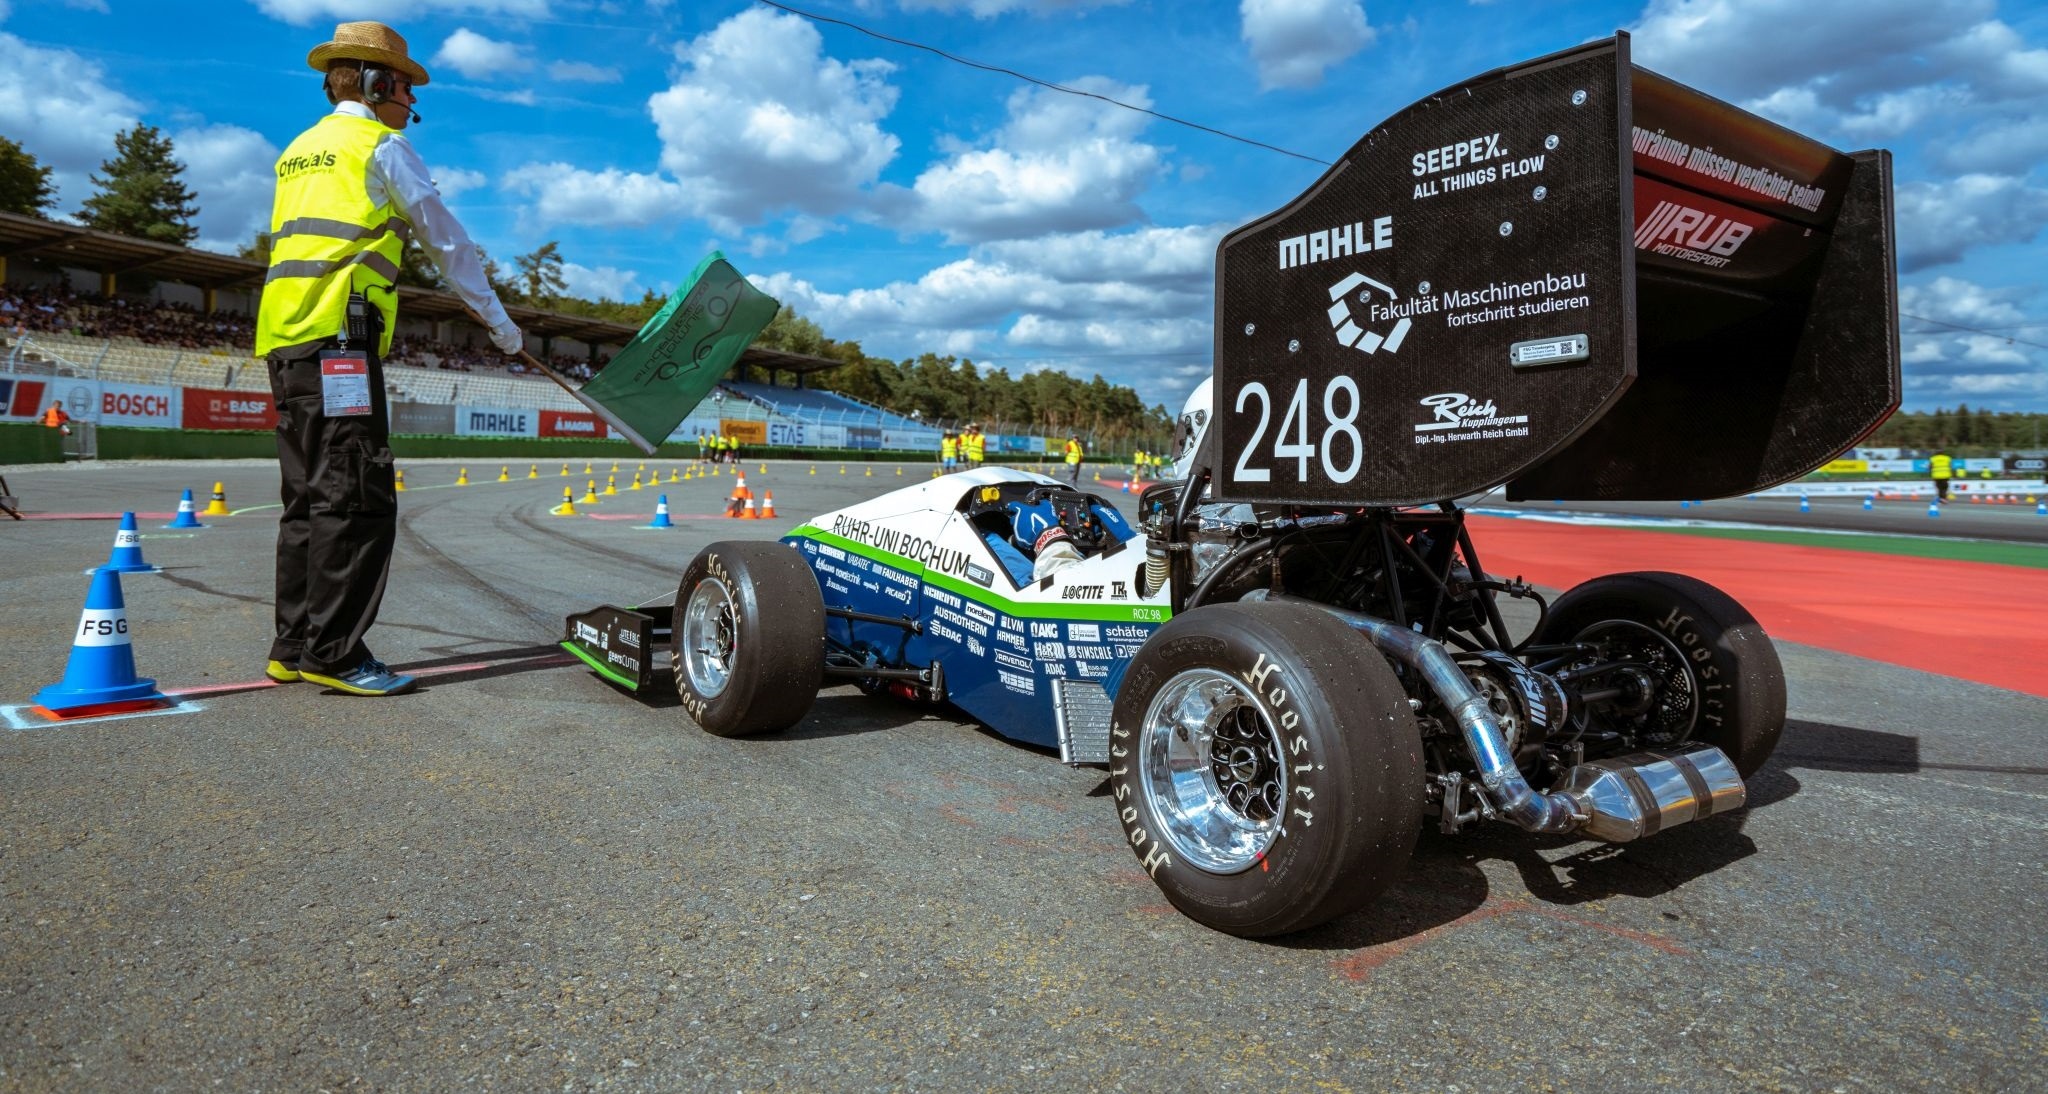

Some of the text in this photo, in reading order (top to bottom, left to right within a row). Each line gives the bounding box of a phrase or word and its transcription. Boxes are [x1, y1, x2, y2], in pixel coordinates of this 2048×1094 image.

[279, 150, 336, 178] Officials
[1412, 133, 1508, 177] SEEPEX.
[1413, 155, 1545, 200] ALL THINGS FLOW
[1685, 146, 1737, 184] müssen
[1734, 160, 1795, 202] verdichtet
[1279, 216, 1393, 270] MAHLE
[1652, 242, 1732, 268] MOTORSPORT
[1371, 273, 1587, 322] Fakultät Maschinenbau
[1447, 295, 1590, 327] fortschritt studieren
[102, 392, 168, 416] BOSCH
[229, 400, 268, 414] BASF
[1420, 393, 1497, 424] Reich
[470, 412, 526, 433] MAHLE
[771, 424, 804, 444] ETAS
[1233, 375, 1363, 484] 248
[1415, 427, 1529, 445] Dipl.-Ing. Herwarth Reich GmbH
[118, 534, 139, 543] FSG
[833, 514, 901, 553] RUHR-UNI
[899, 533, 971, 578] BOCHUM
[707, 553, 742, 624] Hoosier
[882, 567, 918, 589] FAULHABER
[1062, 585, 1104, 600] LOCTITE
[933, 605, 988, 637] AUSTROTHERM
[967, 606, 994, 623] norelem
[1007, 617, 1024, 634] LVM
[1133, 609, 1161, 620] ROZ 98
[83, 618, 128, 636] FSG
[941, 626, 962, 643] EDAG
[1105, 625, 1149, 639] schäfer
[996, 630, 1025, 648] HAMMER
[998, 654, 1031, 669] RAVENOL
[1076, 645, 1113, 660] SIMSCALE
[1045, 663, 1067, 676] ADAC
[1656, 606, 1731, 729] Hoosier
[1242, 653, 1326, 827] Hoosier
[1111, 721, 1173, 879] Hoosier
